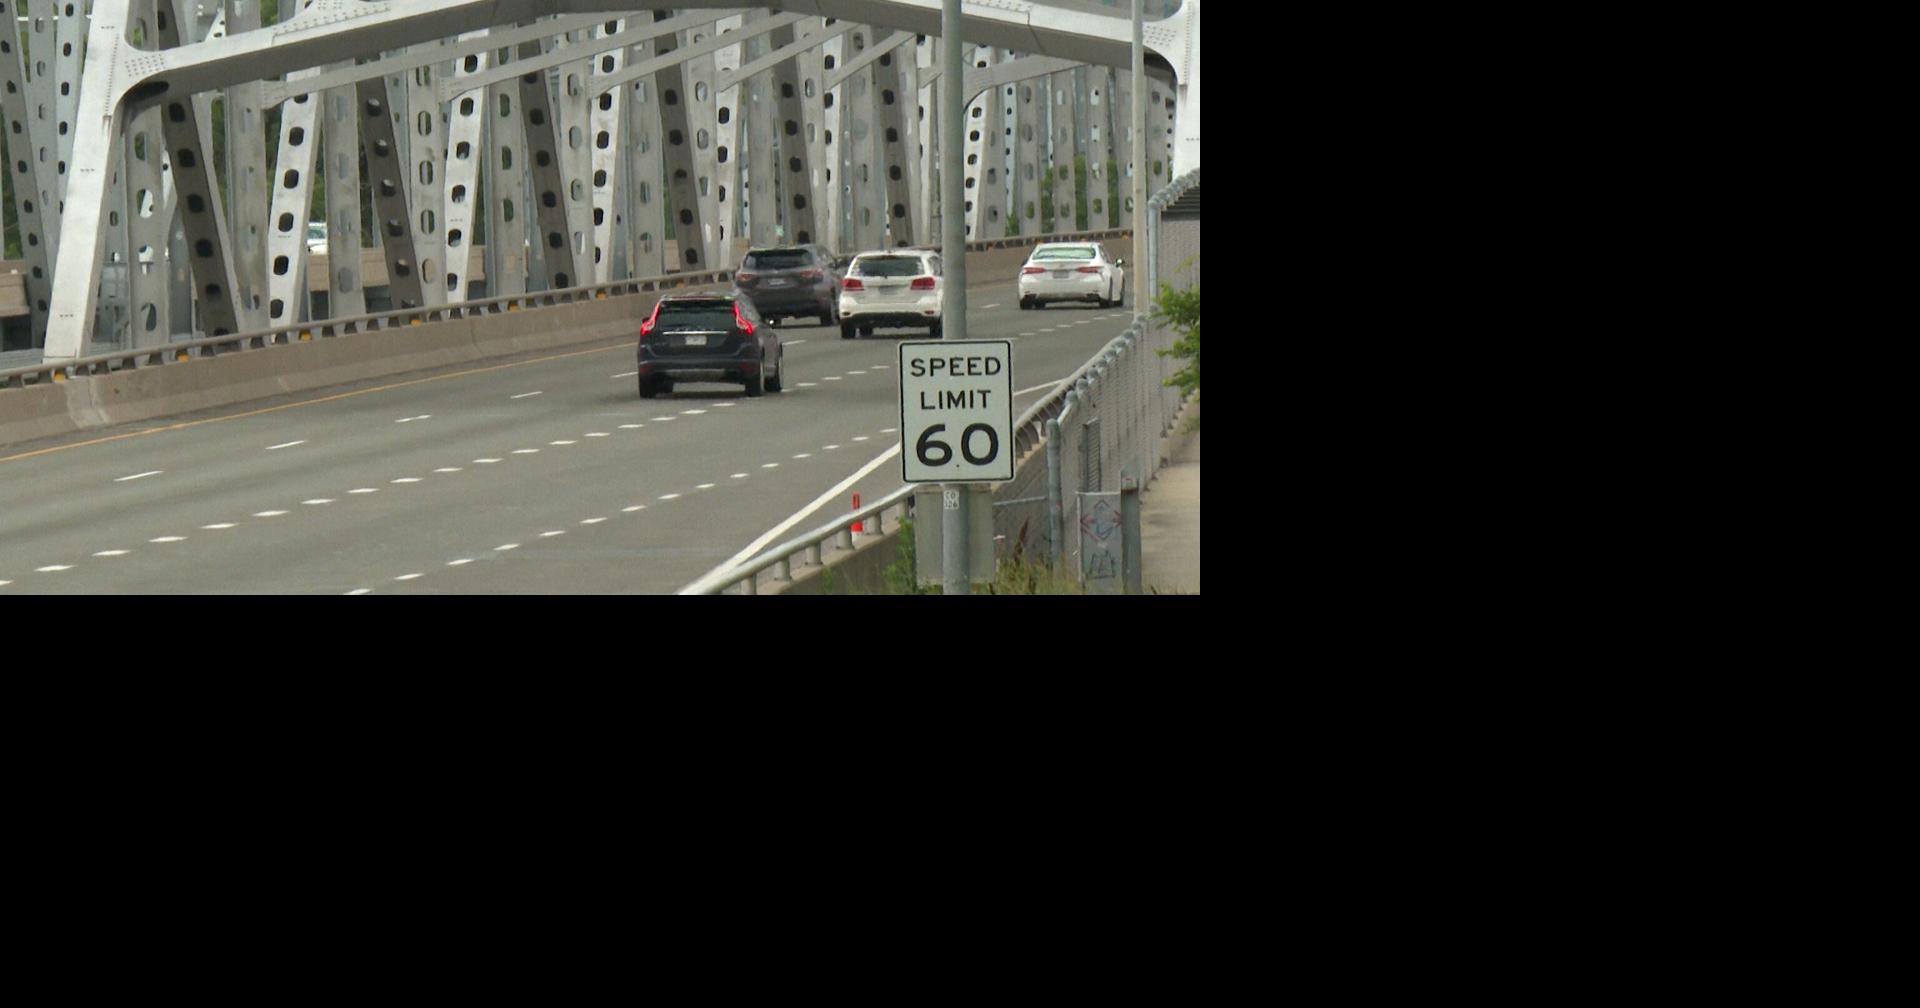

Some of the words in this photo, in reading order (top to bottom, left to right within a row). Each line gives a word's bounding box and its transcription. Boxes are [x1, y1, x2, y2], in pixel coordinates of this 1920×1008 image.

[910, 356, 1002, 378] SPEED
[920, 389, 992, 410] LIMIT
[915, 422, 1000, 468] 60
